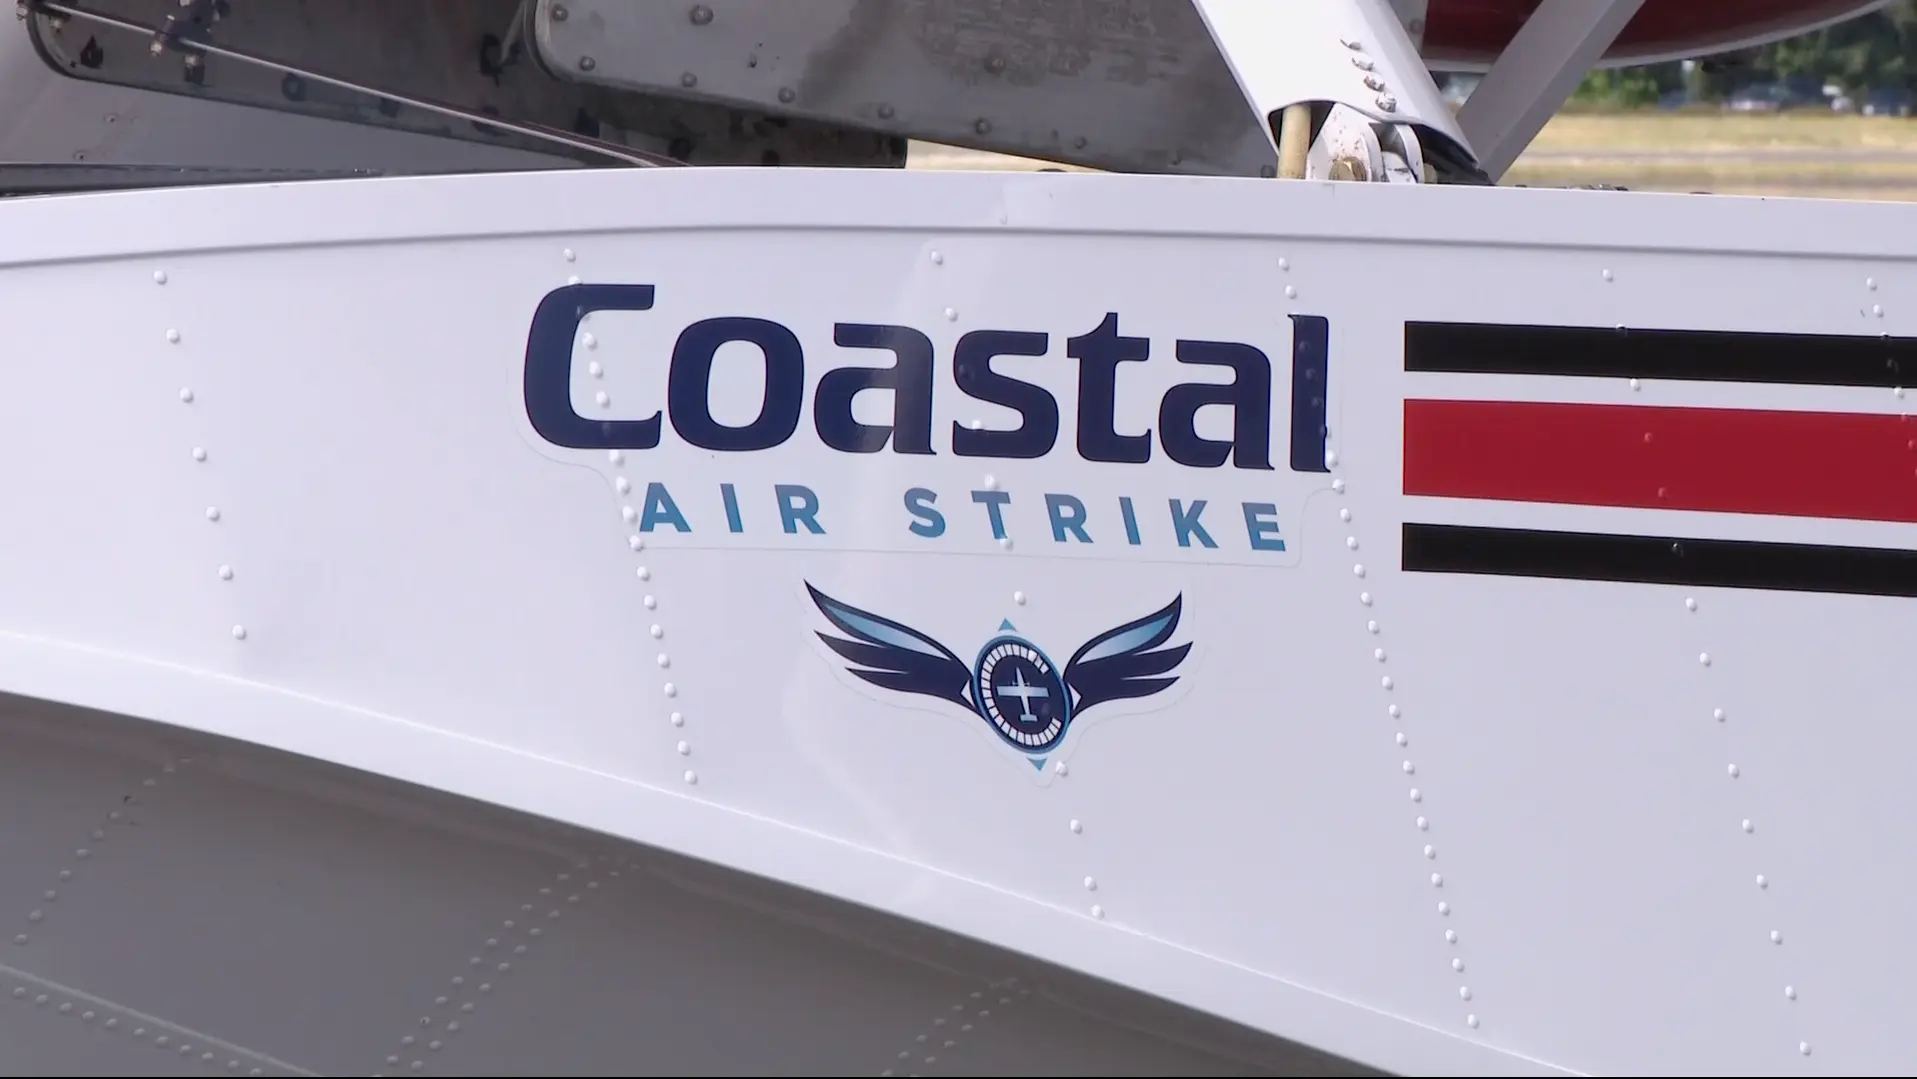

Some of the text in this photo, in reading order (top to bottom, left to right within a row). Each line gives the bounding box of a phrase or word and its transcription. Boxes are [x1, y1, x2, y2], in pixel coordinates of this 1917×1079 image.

[523, 283, 1332, 473] Coastal
[639, 482, 1287, 552] AIR STRIKE
